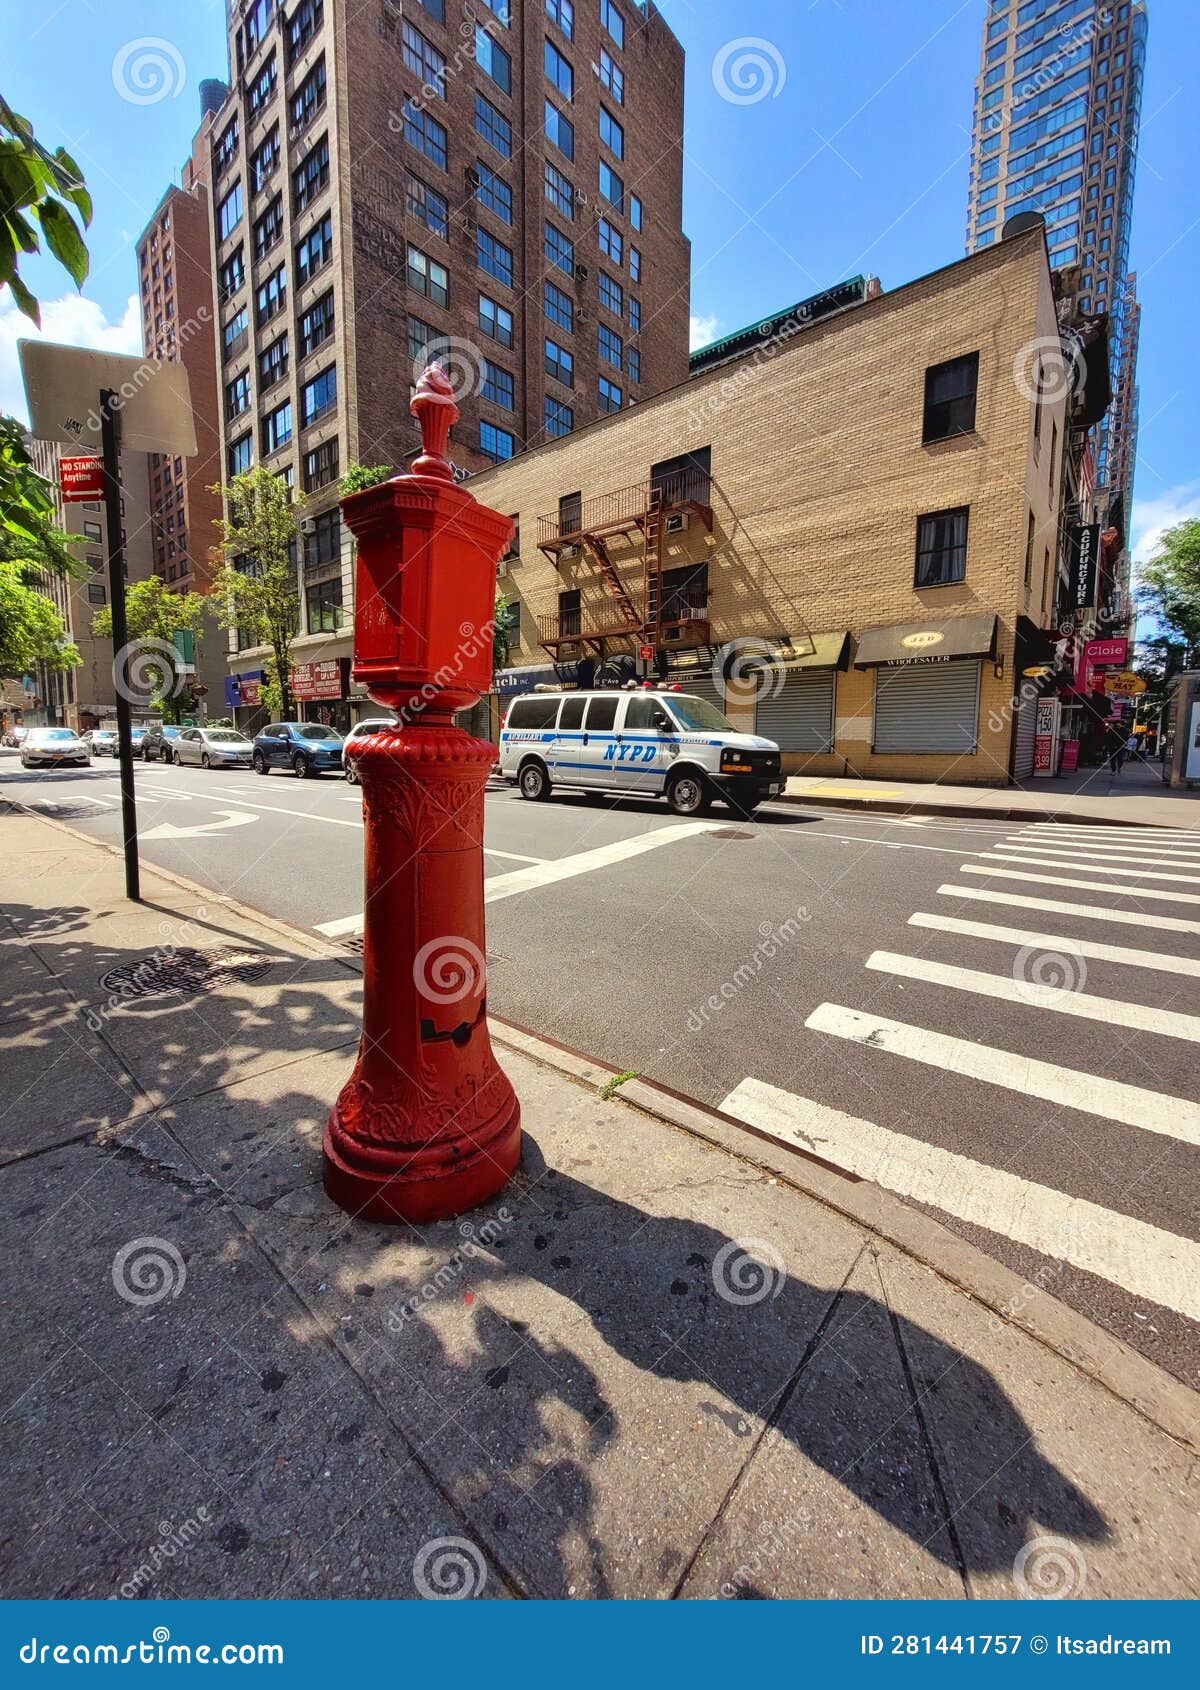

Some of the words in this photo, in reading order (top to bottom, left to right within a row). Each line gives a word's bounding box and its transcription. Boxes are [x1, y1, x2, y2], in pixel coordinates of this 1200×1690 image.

[62, 462, 72, 471] NO
[73, 461, 104, 470] STANDIN
[64, 472, 91, 483] Anytime
[1077, 529, 1091, 605] ACUPUNCTURE
[1087, 645, 1123, 656] Cloie
[887, 655, 950, 666] WHOLESALER
[604, 744, 657, 762] NYPD
